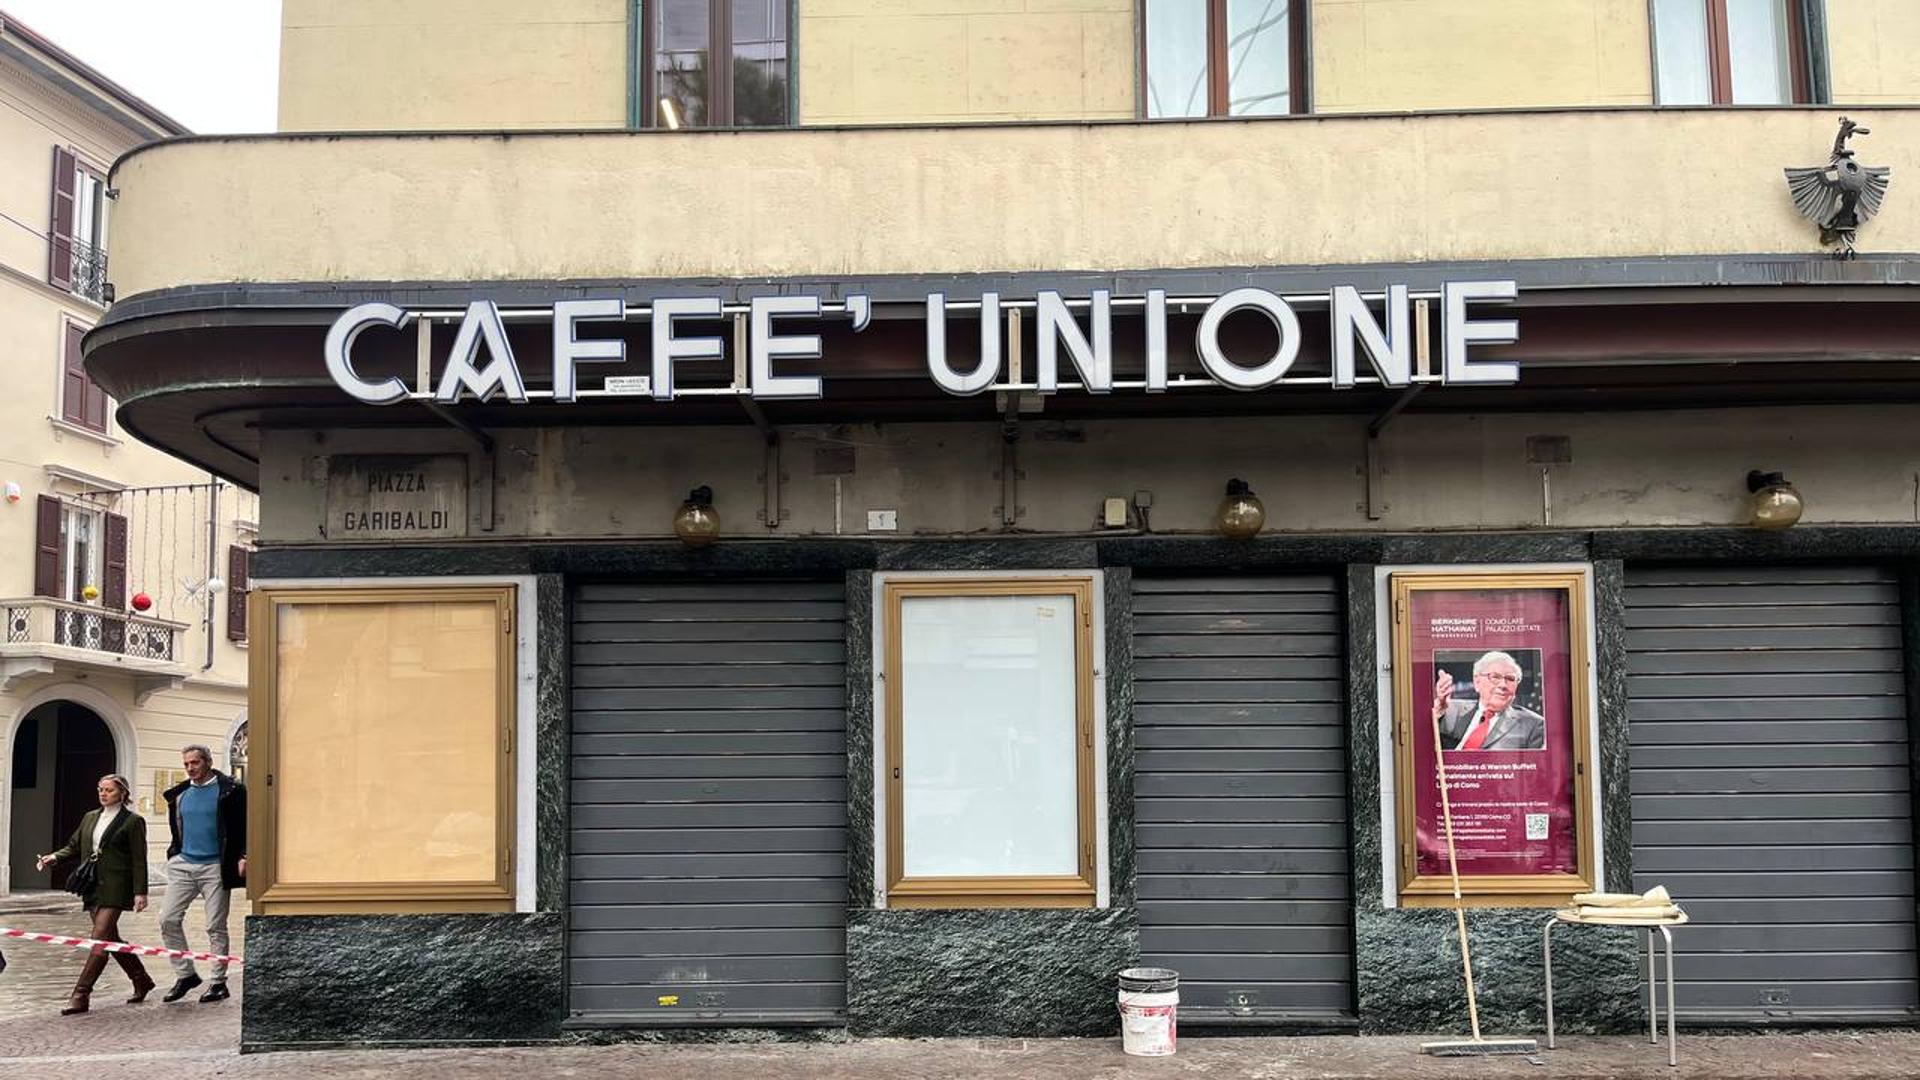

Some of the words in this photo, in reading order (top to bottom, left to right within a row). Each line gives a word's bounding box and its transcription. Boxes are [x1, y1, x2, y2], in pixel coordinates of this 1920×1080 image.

[324, 294, 871, 405] CAFFE'
[926, 280, 1519, 395] UNIONE
[368, 473, 426, 493] PIAZZA
[345, 511, 448, 531] GARIBALDI
[1460, 781, 1480, 789] Como
